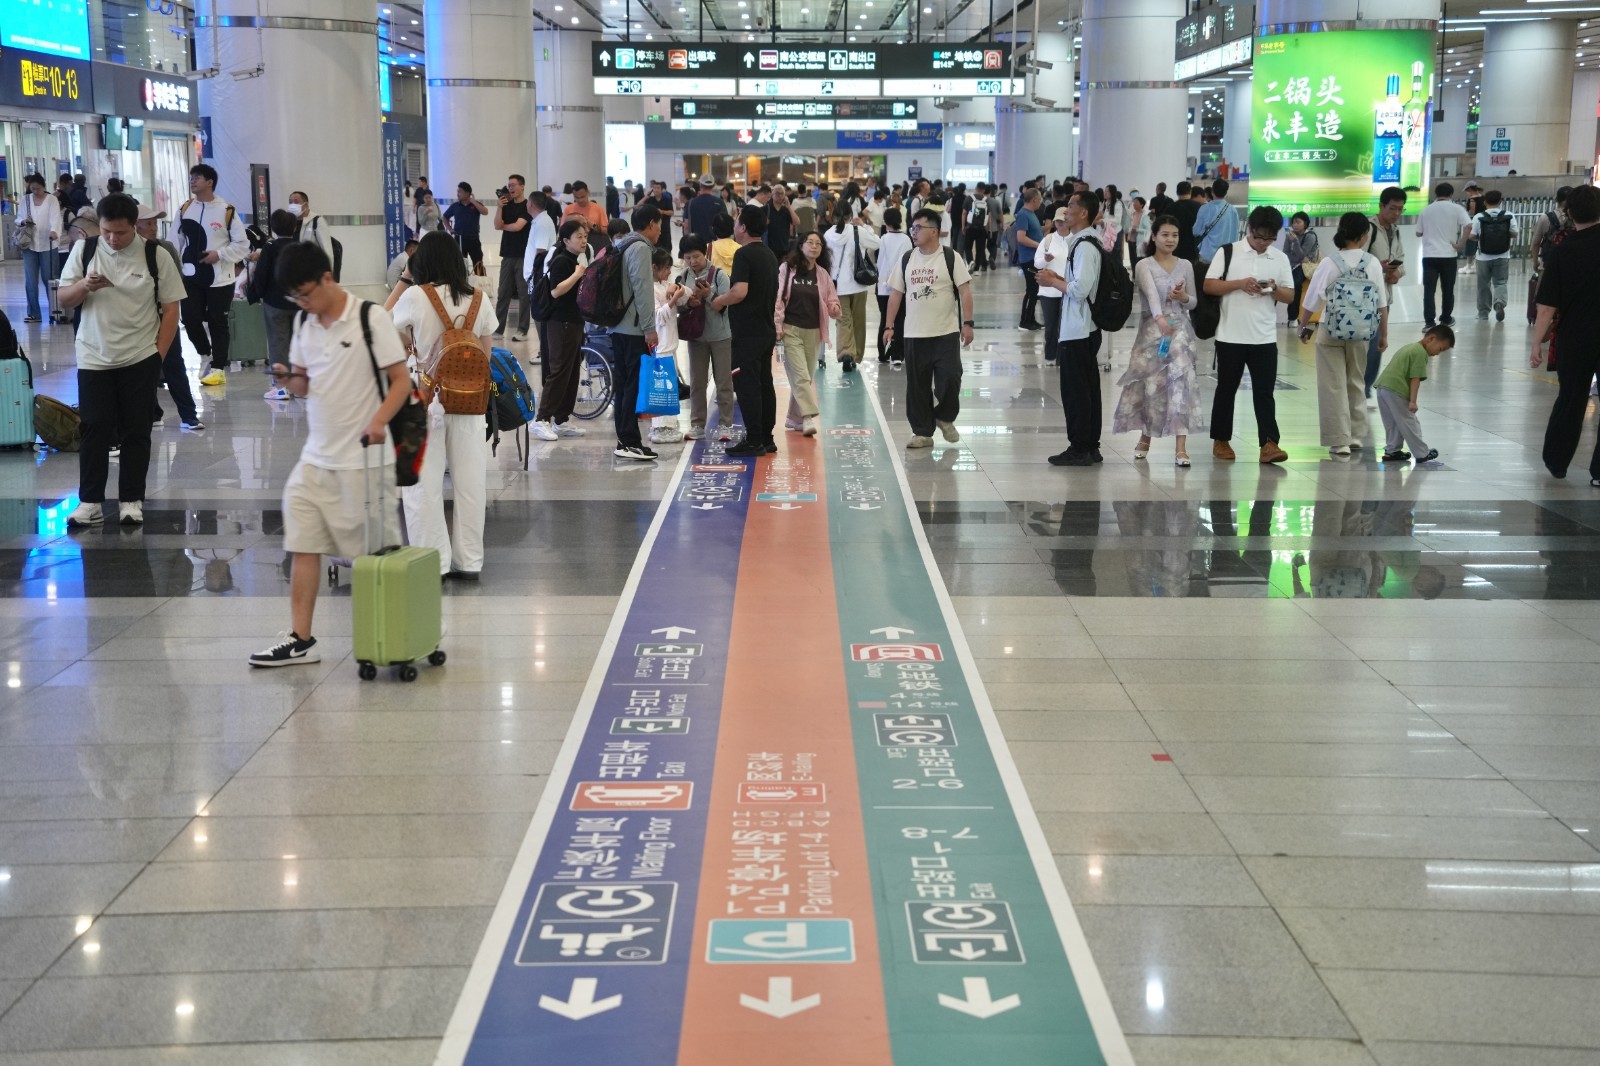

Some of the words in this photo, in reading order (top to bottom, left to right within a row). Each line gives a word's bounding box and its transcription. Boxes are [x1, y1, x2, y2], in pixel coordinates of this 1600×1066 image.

[635, 61, 656, 69] Parking
[636, 50, 665, 62] 停车场
[688, 50, 716, 62] 出租车
[779, 51, 826, 62] 南公交枢纽
[848, 51, 876, 62] 南出口
[963, 62, 983, 70] Subway
[33, 63, 49, 82] 检票口
[50, 66, 78, 99] 10-13
[1263, 75, 1344, 106] 二锅头
[757, 129, 798, 144] KFC
[1262, 109, 1343, 144] 永丰造
[1383, 142, 1395, 170] 无争
[660, 657, 694, 679] 南出口
[897, 671, 943, 690] 地铁
[624, 690, 660, 716] 北出口
[599, 740, 651, 778] 出租车
[656, 761, 686, 778] Taxi
[747, 752, 783, 781] 网约车
[917, 748, 956, 777] 出站口
[639, 817, 672, 840] Floor
[630, 842, 676, 879] Waiting
[799, 850, 830, 868] Lot
[910, 856, 956, 898] 出站口
[799, 869, 839, 914] Parking
